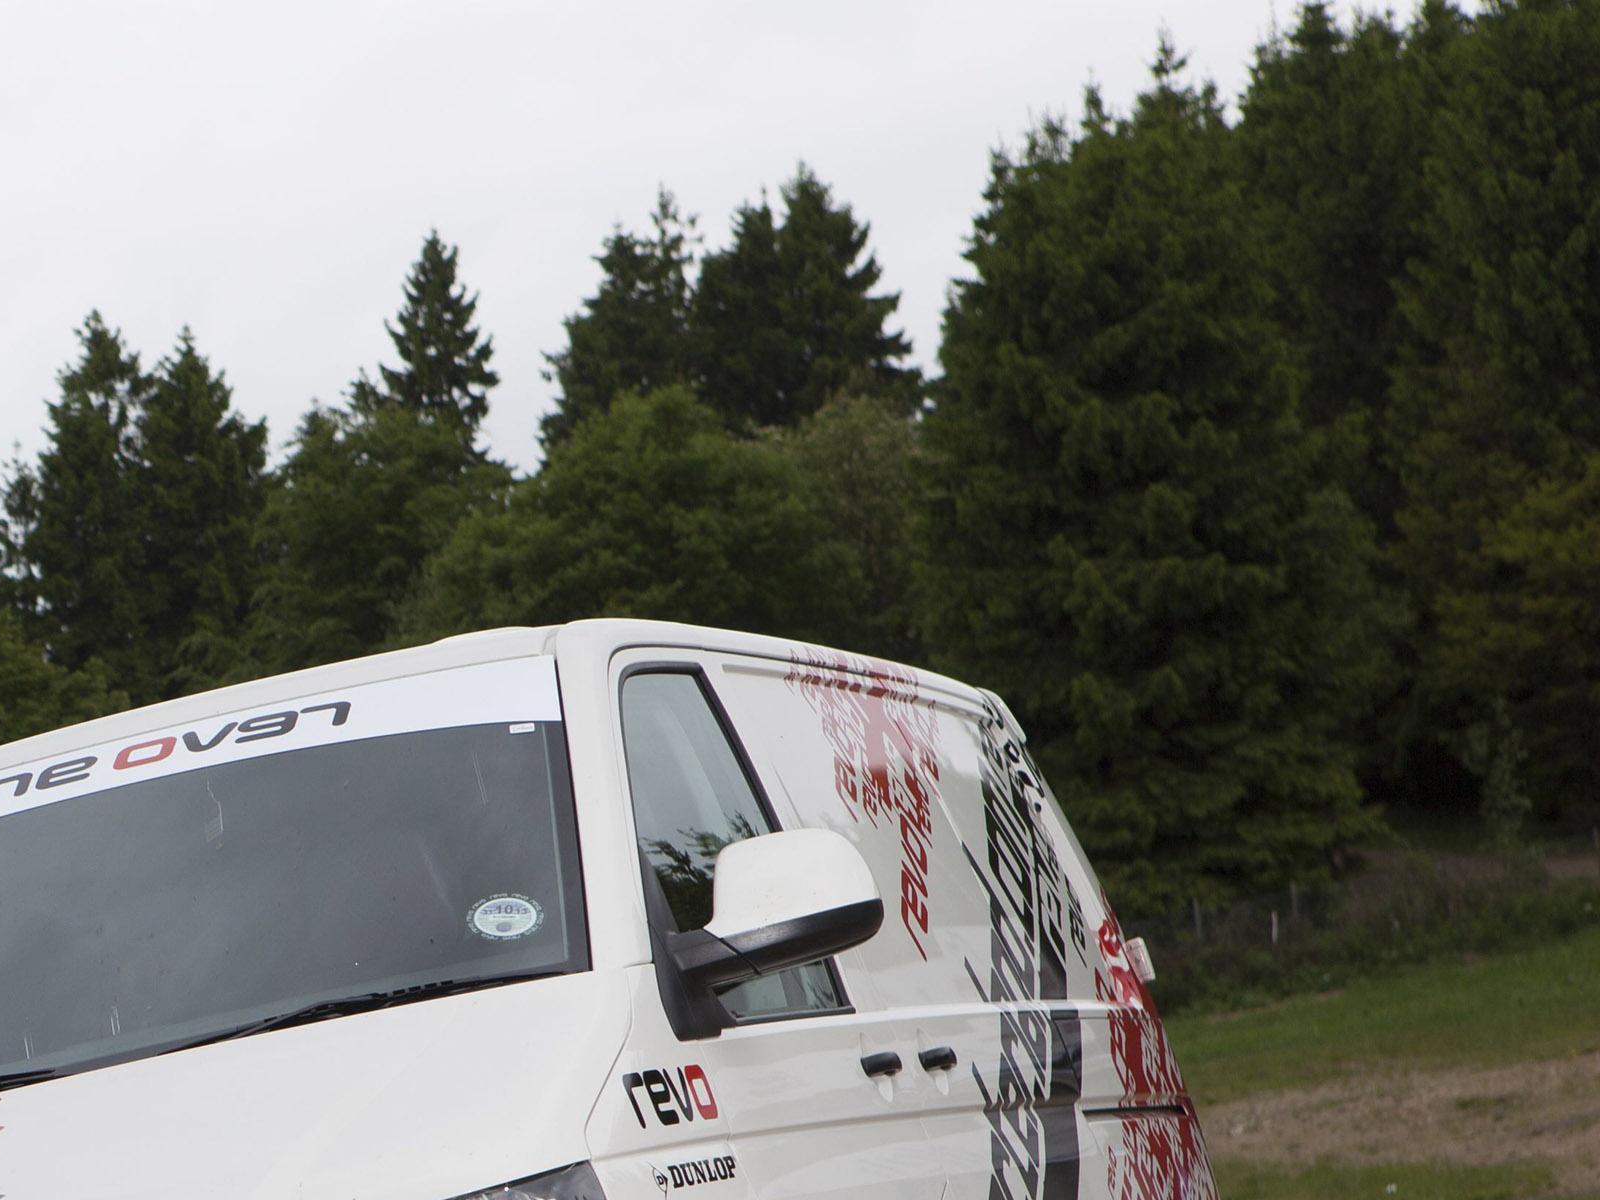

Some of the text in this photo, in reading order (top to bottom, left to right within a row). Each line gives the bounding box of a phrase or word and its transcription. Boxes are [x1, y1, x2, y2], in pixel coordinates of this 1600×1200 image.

[901, 812, 929, 963] revo
[622, 1064, 718, 1129] revo
[667, 1155, 736, 1188] DUNLOP
